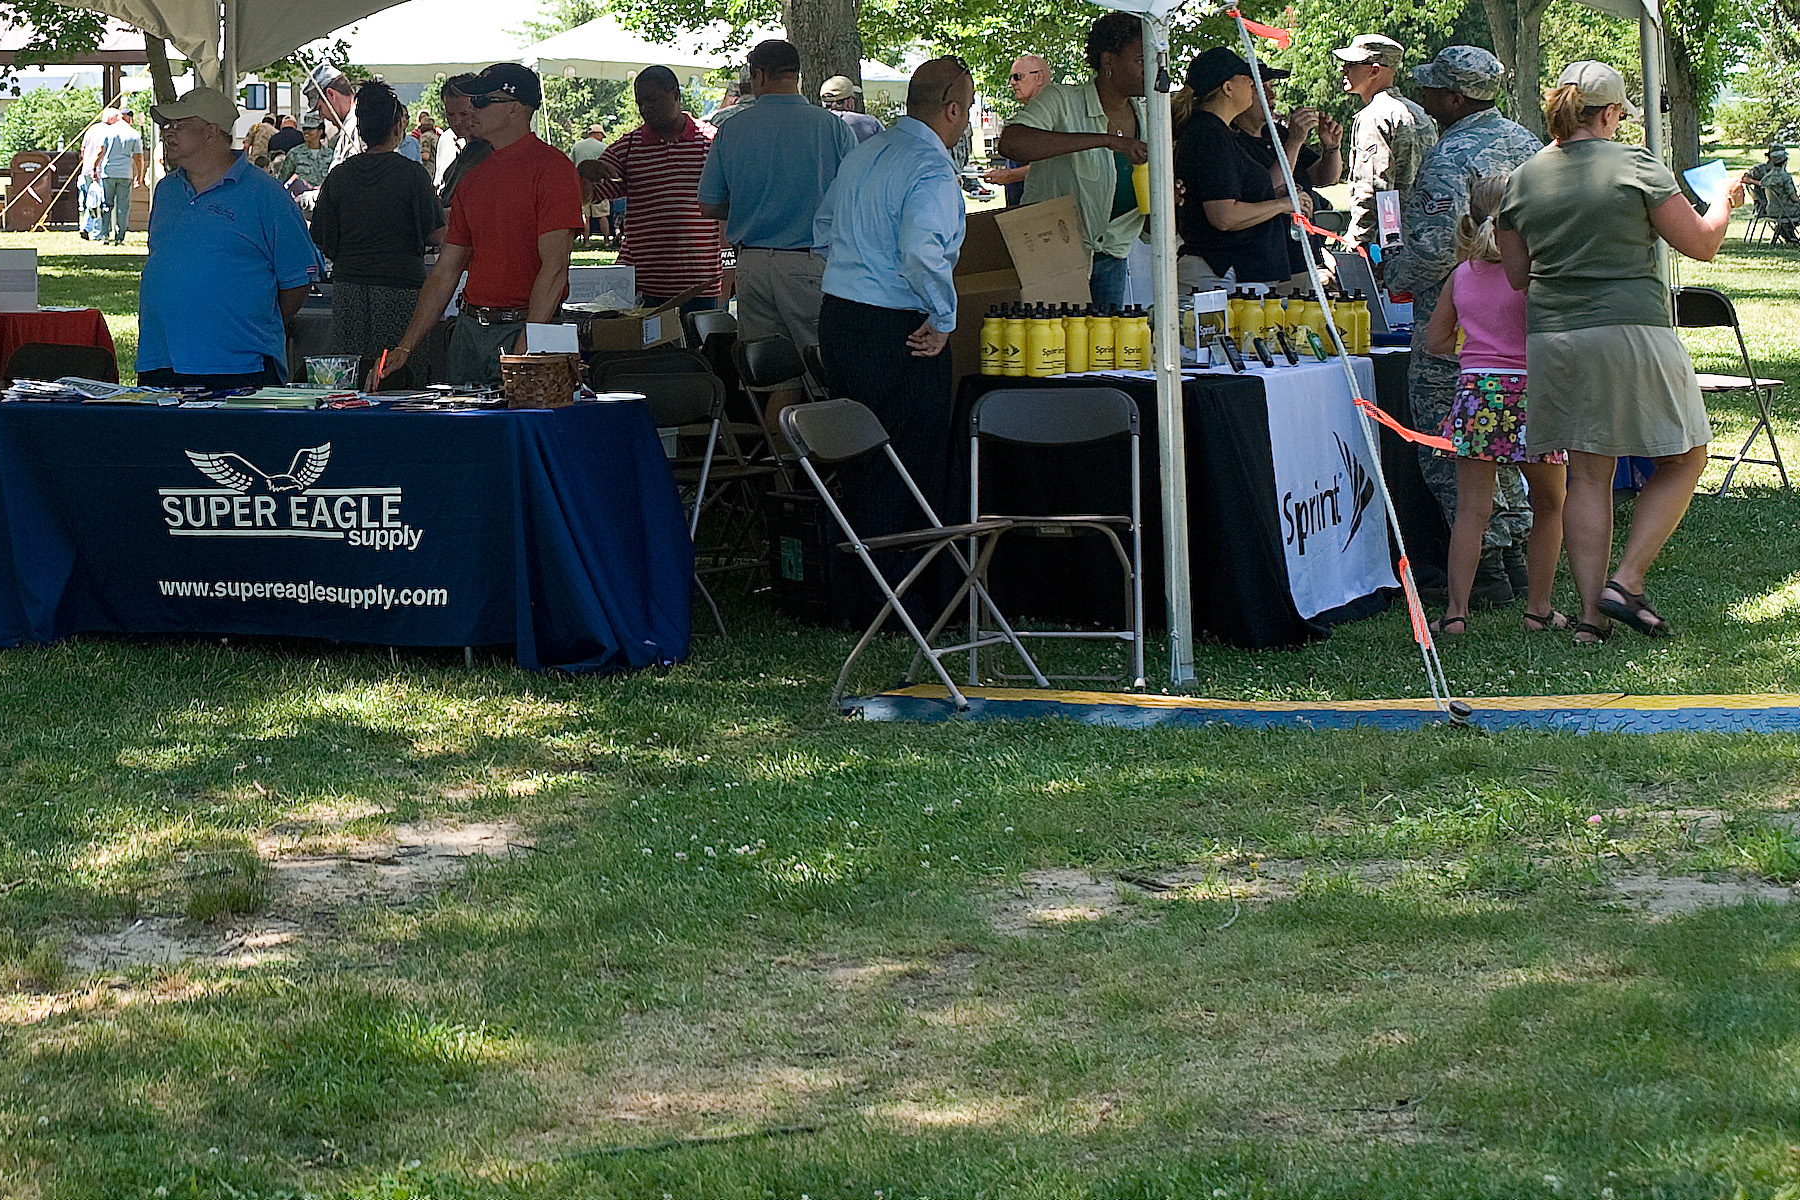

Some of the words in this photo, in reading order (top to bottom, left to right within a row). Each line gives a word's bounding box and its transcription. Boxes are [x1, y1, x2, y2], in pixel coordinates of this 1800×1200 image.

[162, 496, 277, 528] SUPER
[290, 496, 402, 528] EAGLE
[1283, 474, 1341, 556] Sprint
[348, 526, 423, 551] supply
[158, 580, 449, 610] www.supereaglesupply.com
